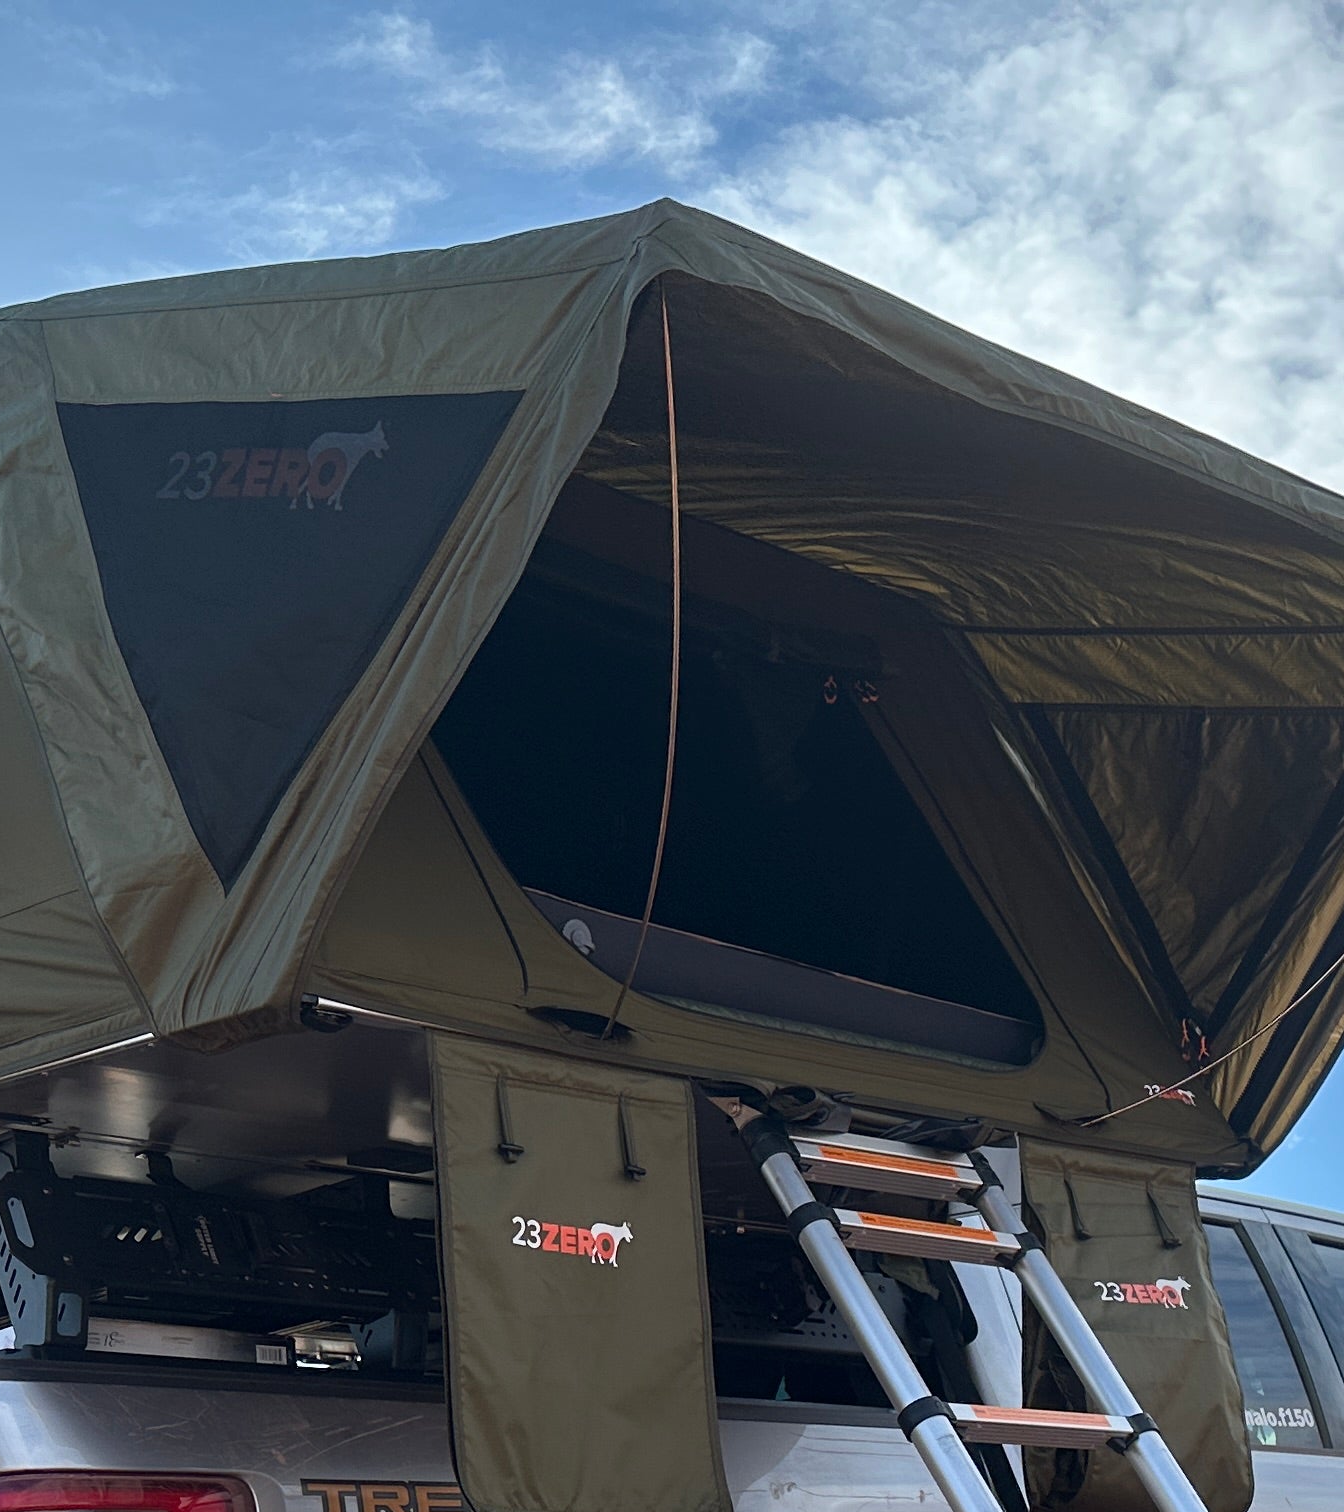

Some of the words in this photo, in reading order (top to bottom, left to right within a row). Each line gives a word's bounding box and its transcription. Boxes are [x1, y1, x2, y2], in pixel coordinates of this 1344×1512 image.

[155, 446, 350, 501] 23ZERO
[512, 1215, 616, 1261] 23ZERO
[1093, 1281, 1181, 1305] 23ZERO
